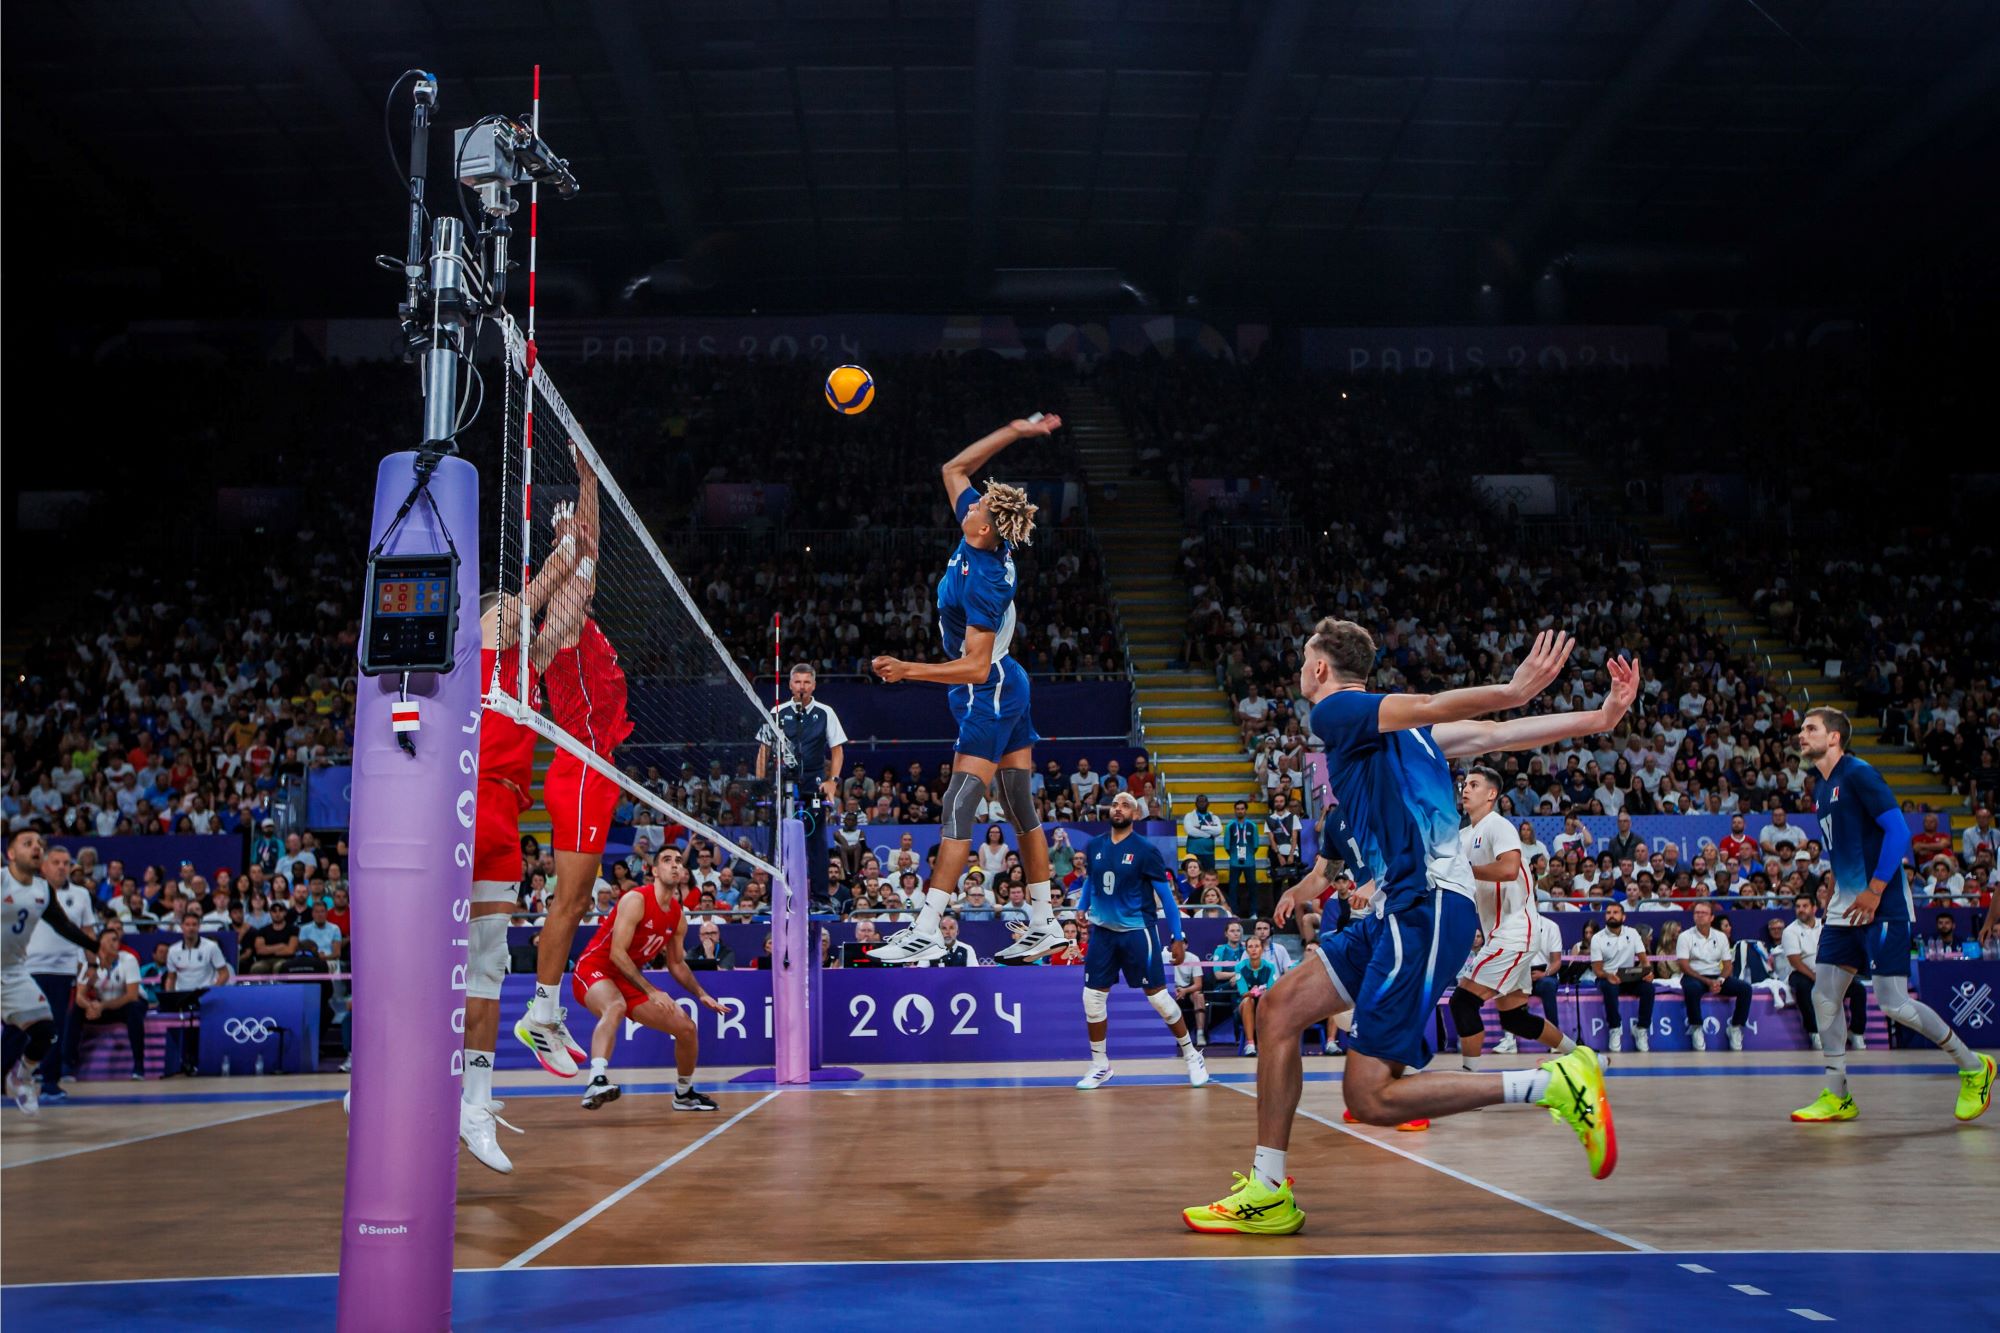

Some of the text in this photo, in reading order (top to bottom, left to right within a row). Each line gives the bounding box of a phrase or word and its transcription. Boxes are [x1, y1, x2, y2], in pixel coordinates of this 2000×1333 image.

[589, 826, 598, 843] 7
[1102, 870, 1116, 896] 9
[12, 909, 29, 935] 3
[639, 933, 665, 957] 10
[849, 992, 1022, 1037] 2024
[368, 1224, 408, 1235] Senoh
